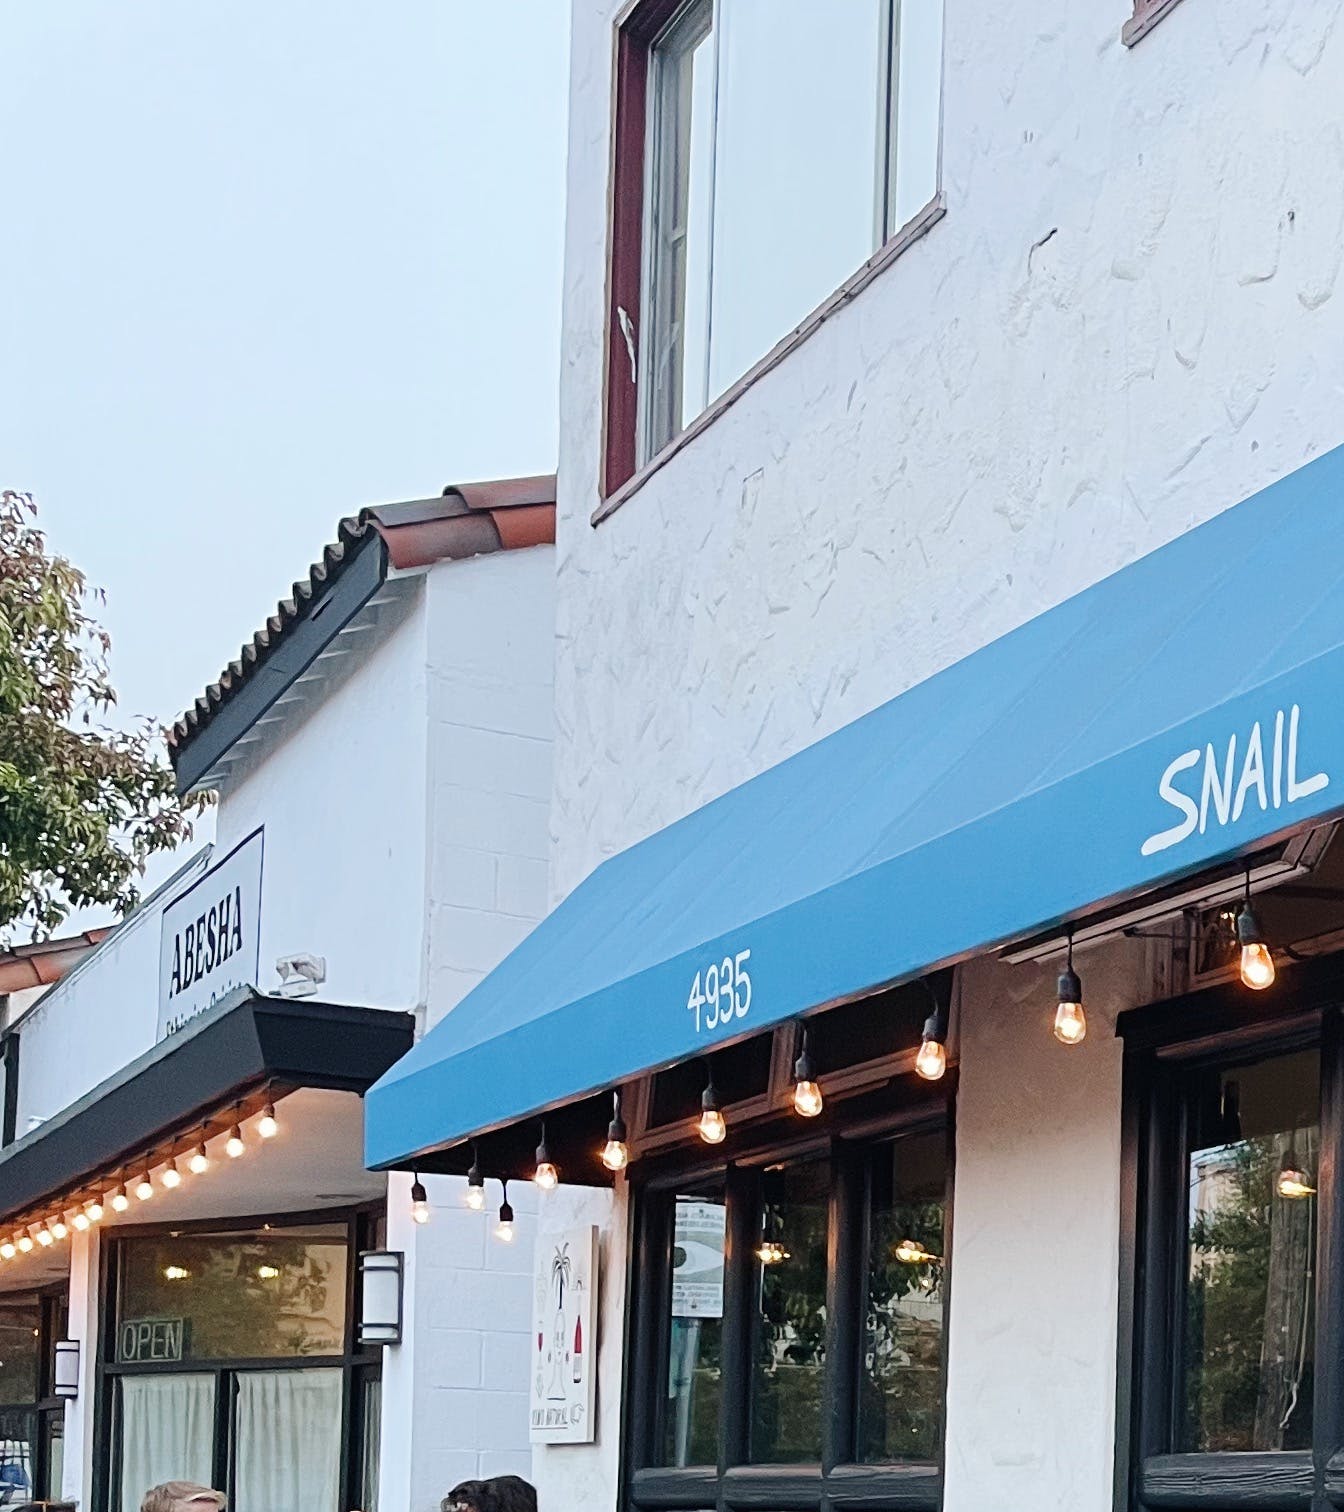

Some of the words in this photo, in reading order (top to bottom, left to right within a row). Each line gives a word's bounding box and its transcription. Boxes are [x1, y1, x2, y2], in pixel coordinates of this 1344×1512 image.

[1141, 702, 1329, 856] SNAIL
[169, 885, 243, 999] ABESHA
[686, 949, 752, 1032] 4935
[123, 1322, 180, 1360] OPEN
